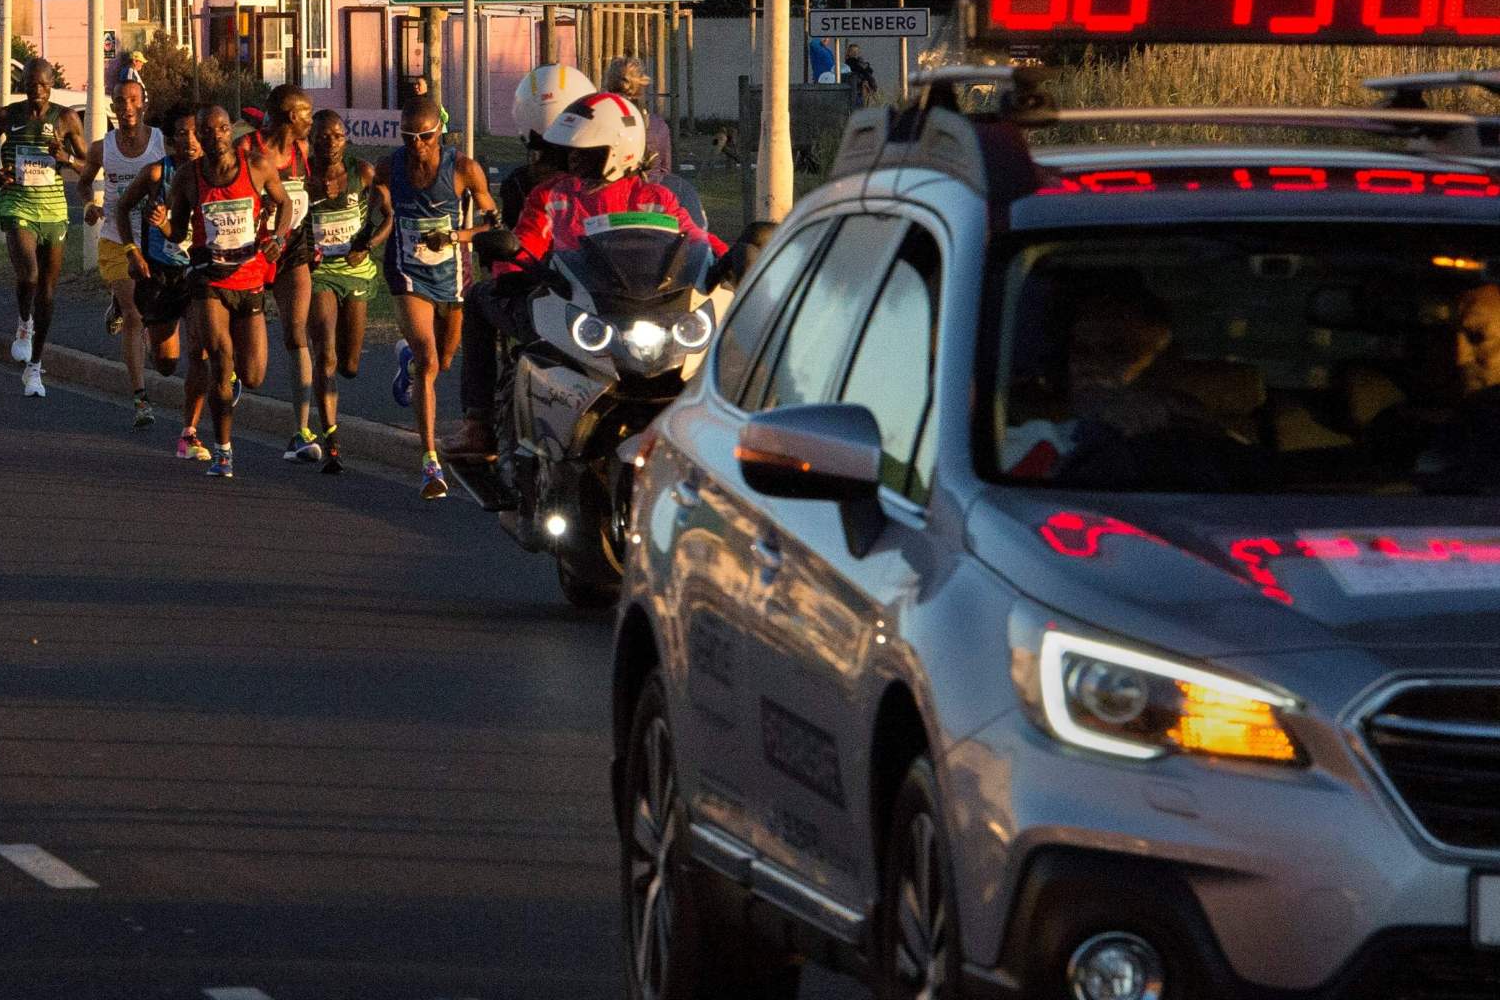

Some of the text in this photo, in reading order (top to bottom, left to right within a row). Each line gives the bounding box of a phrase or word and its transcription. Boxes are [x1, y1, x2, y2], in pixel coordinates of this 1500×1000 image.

[821, 15, 917, 31] STEENBERG
[211, 215, 247, 227] Calvin
[321, 225, 355, 236] Justin
